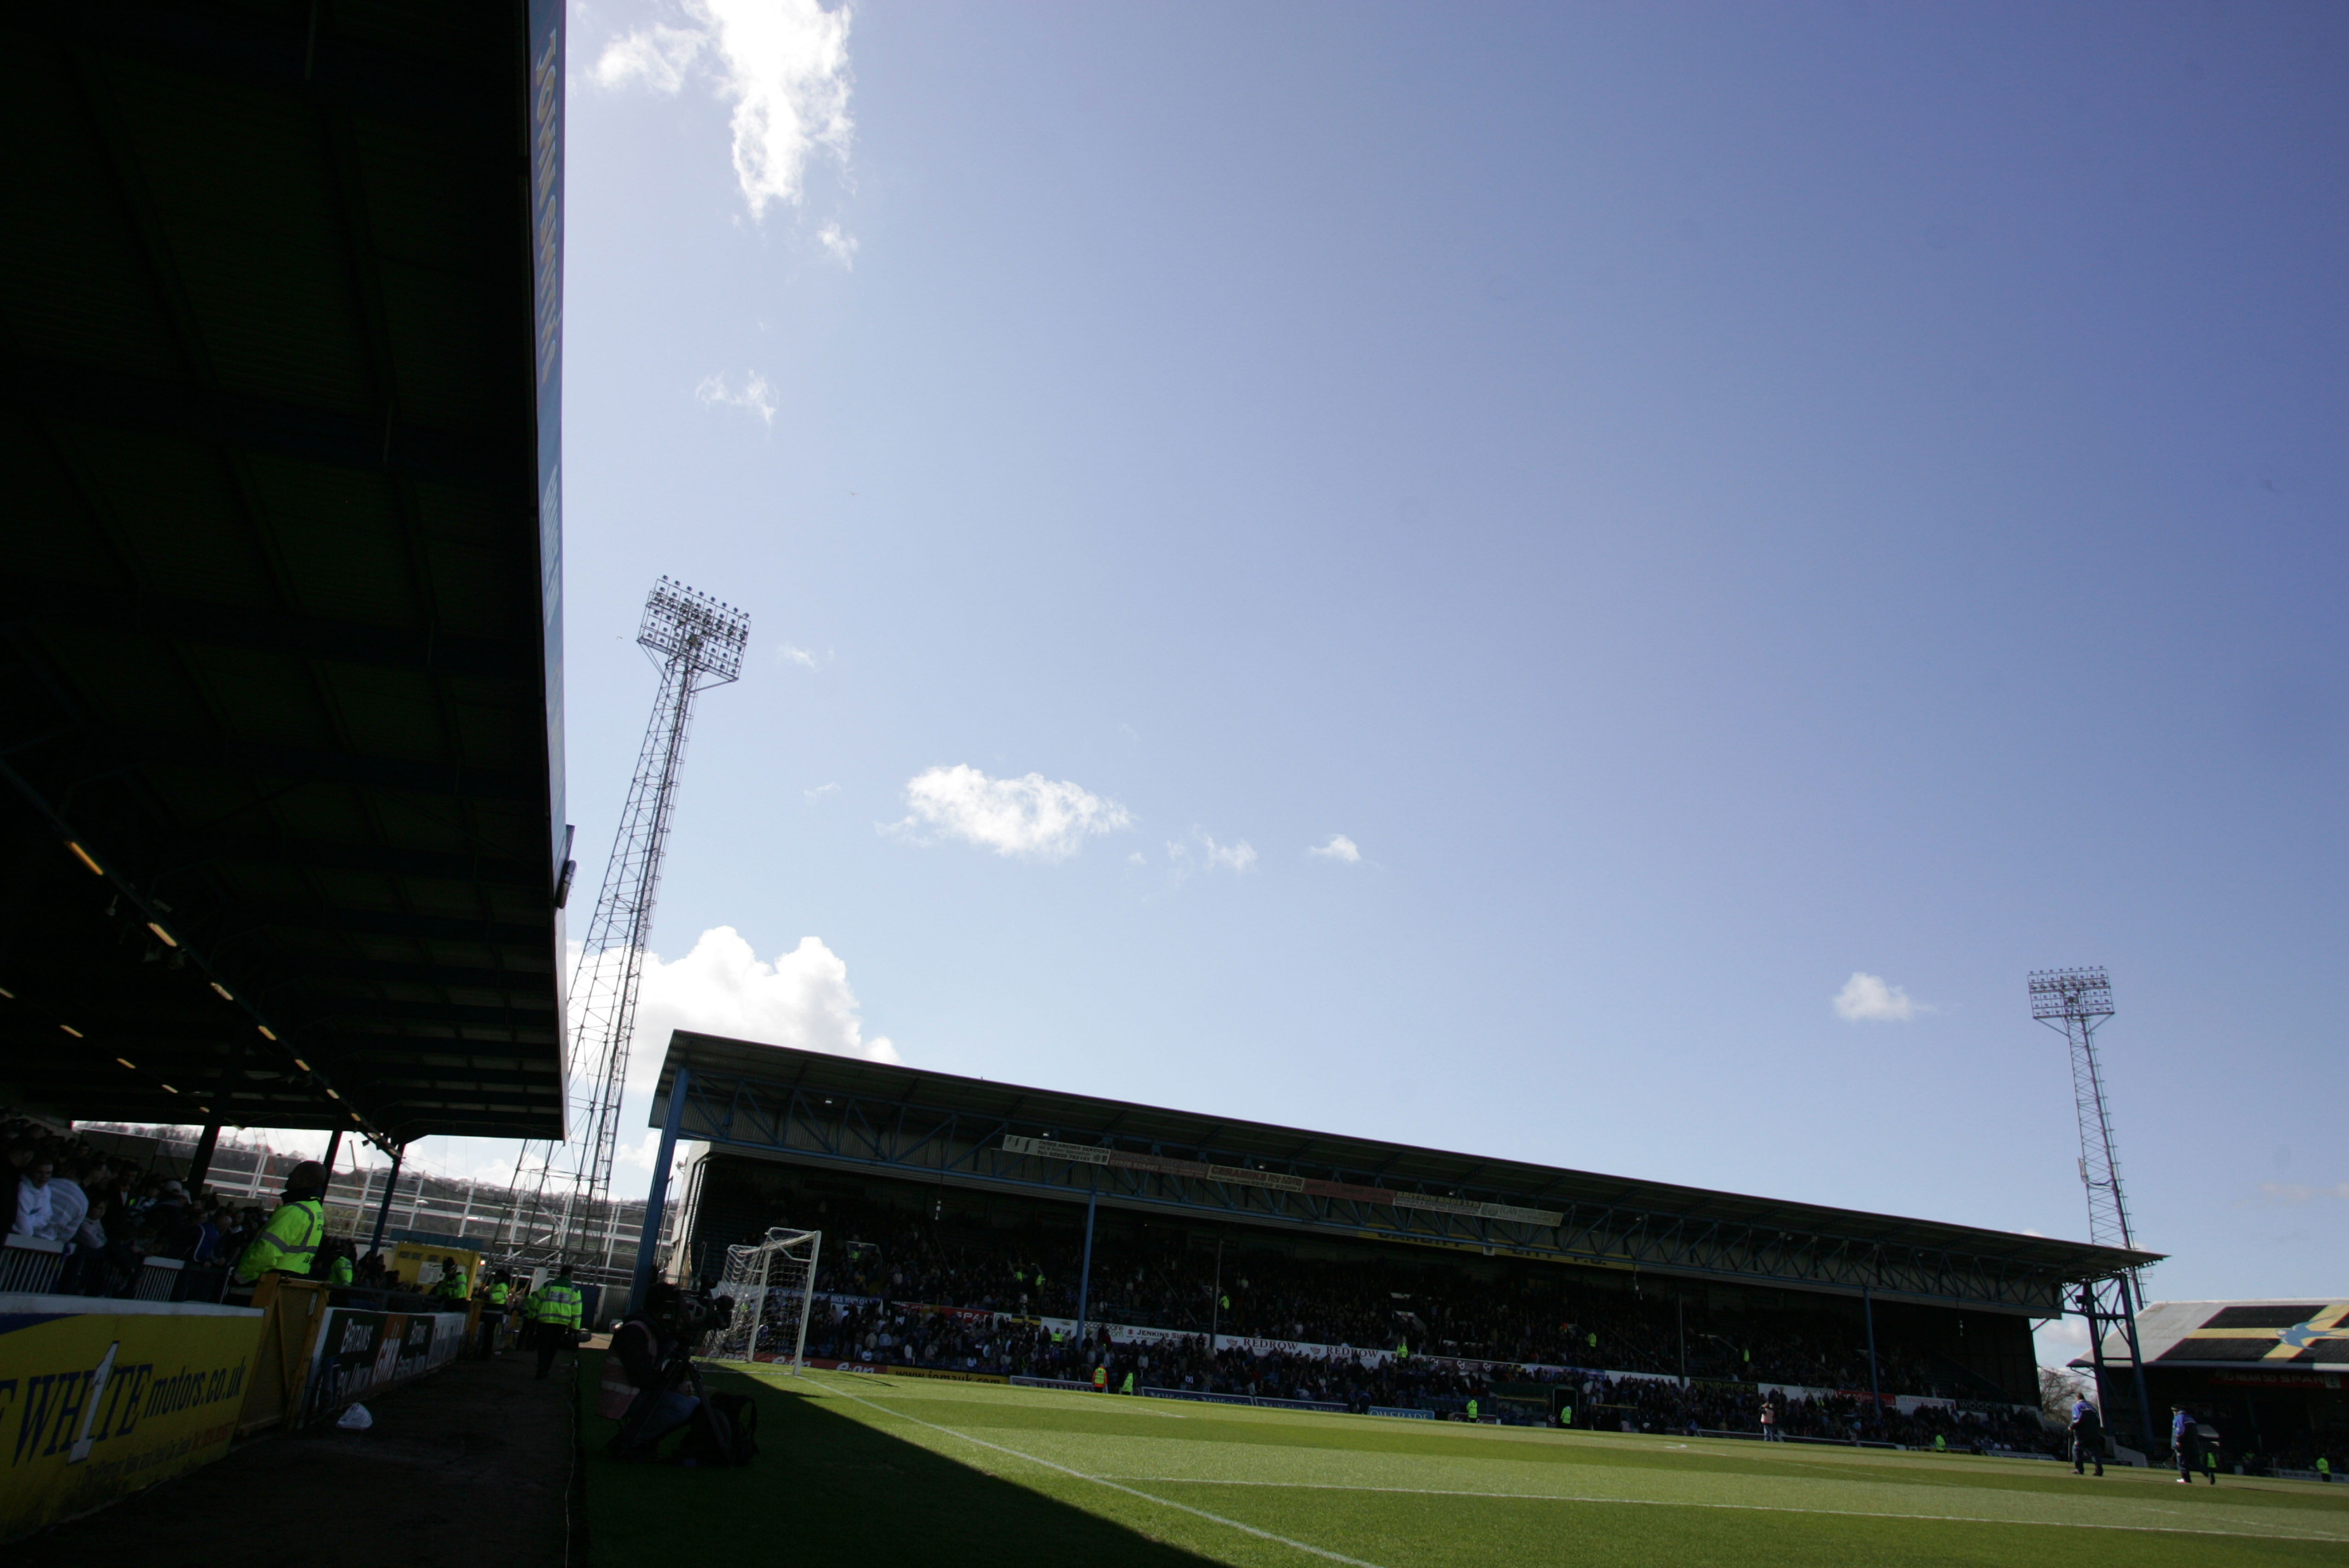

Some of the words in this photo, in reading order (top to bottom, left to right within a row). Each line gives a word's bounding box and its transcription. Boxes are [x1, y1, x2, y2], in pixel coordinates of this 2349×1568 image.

[536, 27, 557, 210] JOHN
[540, 194, 561, 384] SMITH'S
[1211, 1166, 1267, 1181] CERAMIKS
[1397, 1191, 1437, 1202] BRITTON
[1437, 1196, 1461, 1205] BROS
[1137, 1329, 1169, 1338] JENKINS
[1243, 1338, 1299, 1351] REDROW
[2280, 1374, 2325, 1383] SPAR
[12, 1340, 153, 1467] WHITE
[143, 1356, 246, 1419] motors.co.uk
[1367, 1410, 1429, 1420] OWERADE
